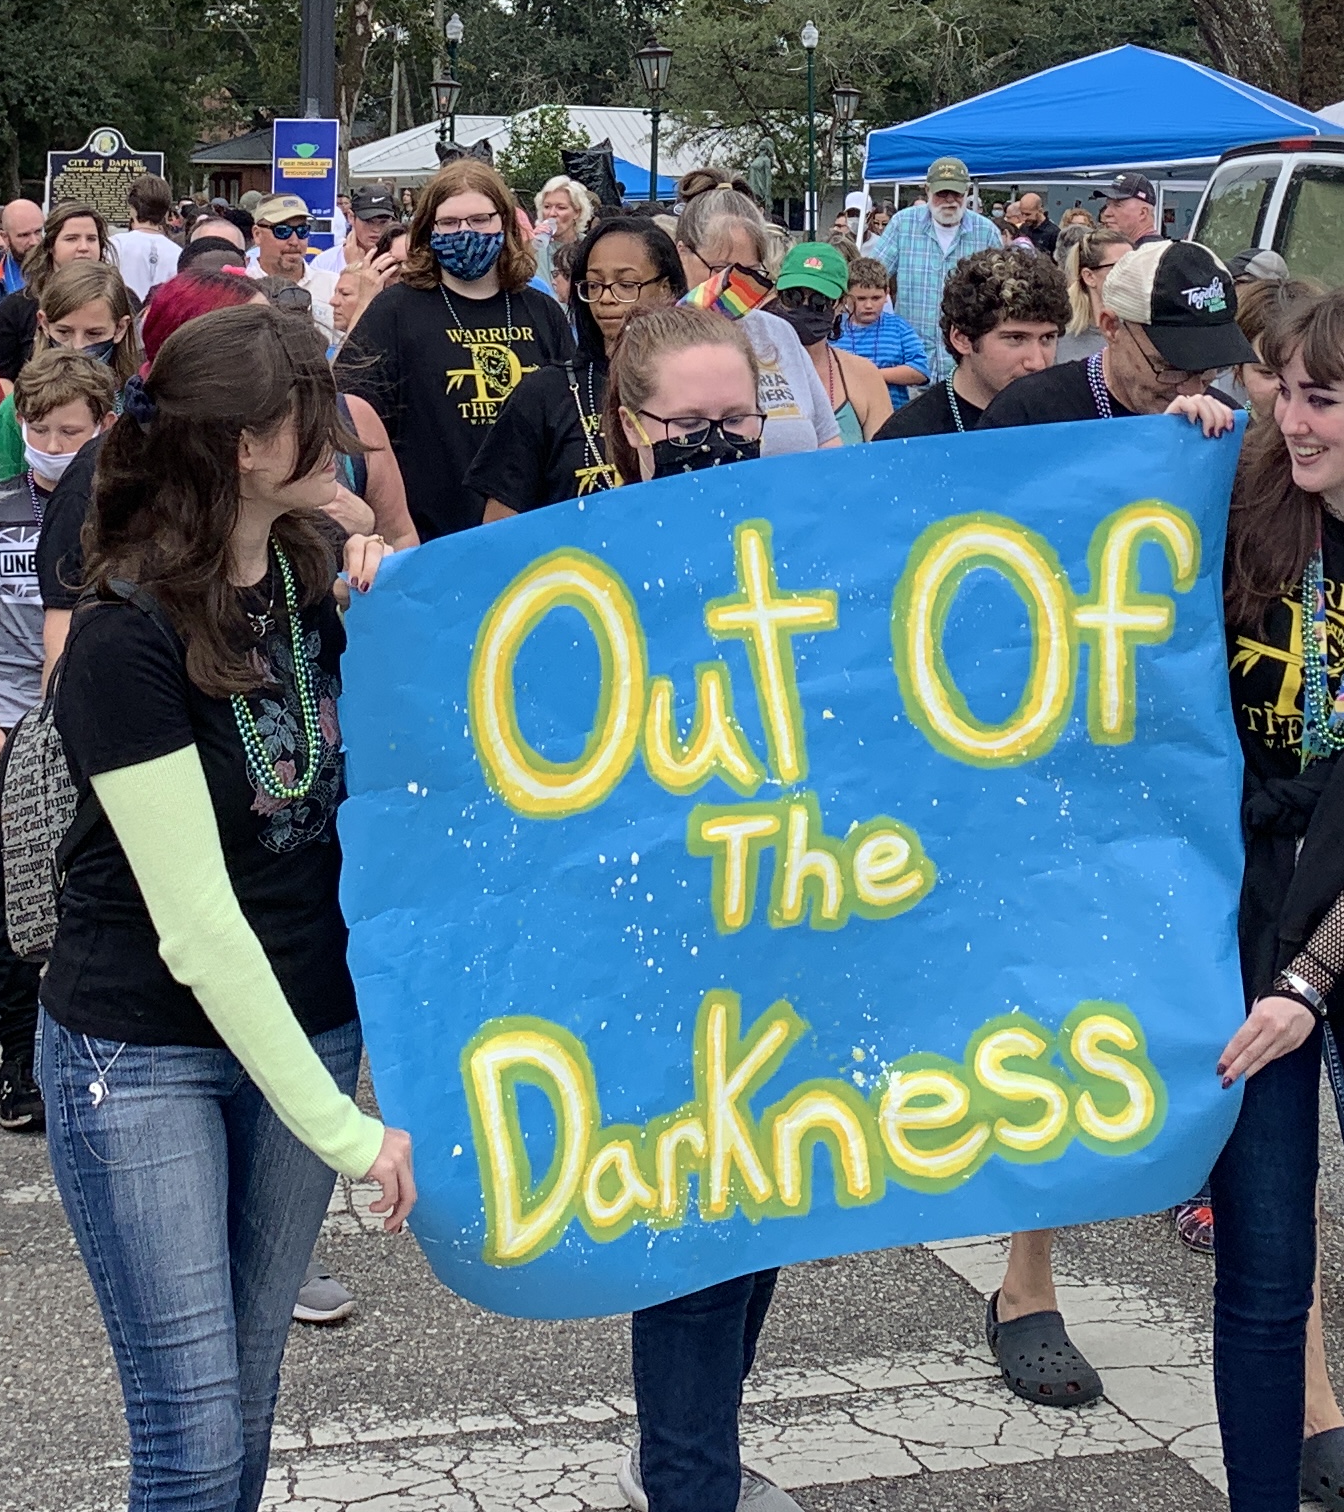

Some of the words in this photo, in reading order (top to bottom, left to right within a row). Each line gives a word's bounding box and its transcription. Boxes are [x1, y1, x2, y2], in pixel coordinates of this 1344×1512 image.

[68, 159, 89, 167] CITY
[93, 159, 105, 167] OF
[109, 159, 143, 167] DAPHNE
[297, 159, 318, 167] masks
[446, 326, 534, 343] WARRIOR
[458, 402, 498, 418] THE
[472, 519, 839, 819] Out
[893, 501, 1201, 767] Of
[687, 792, 937, 933] The
